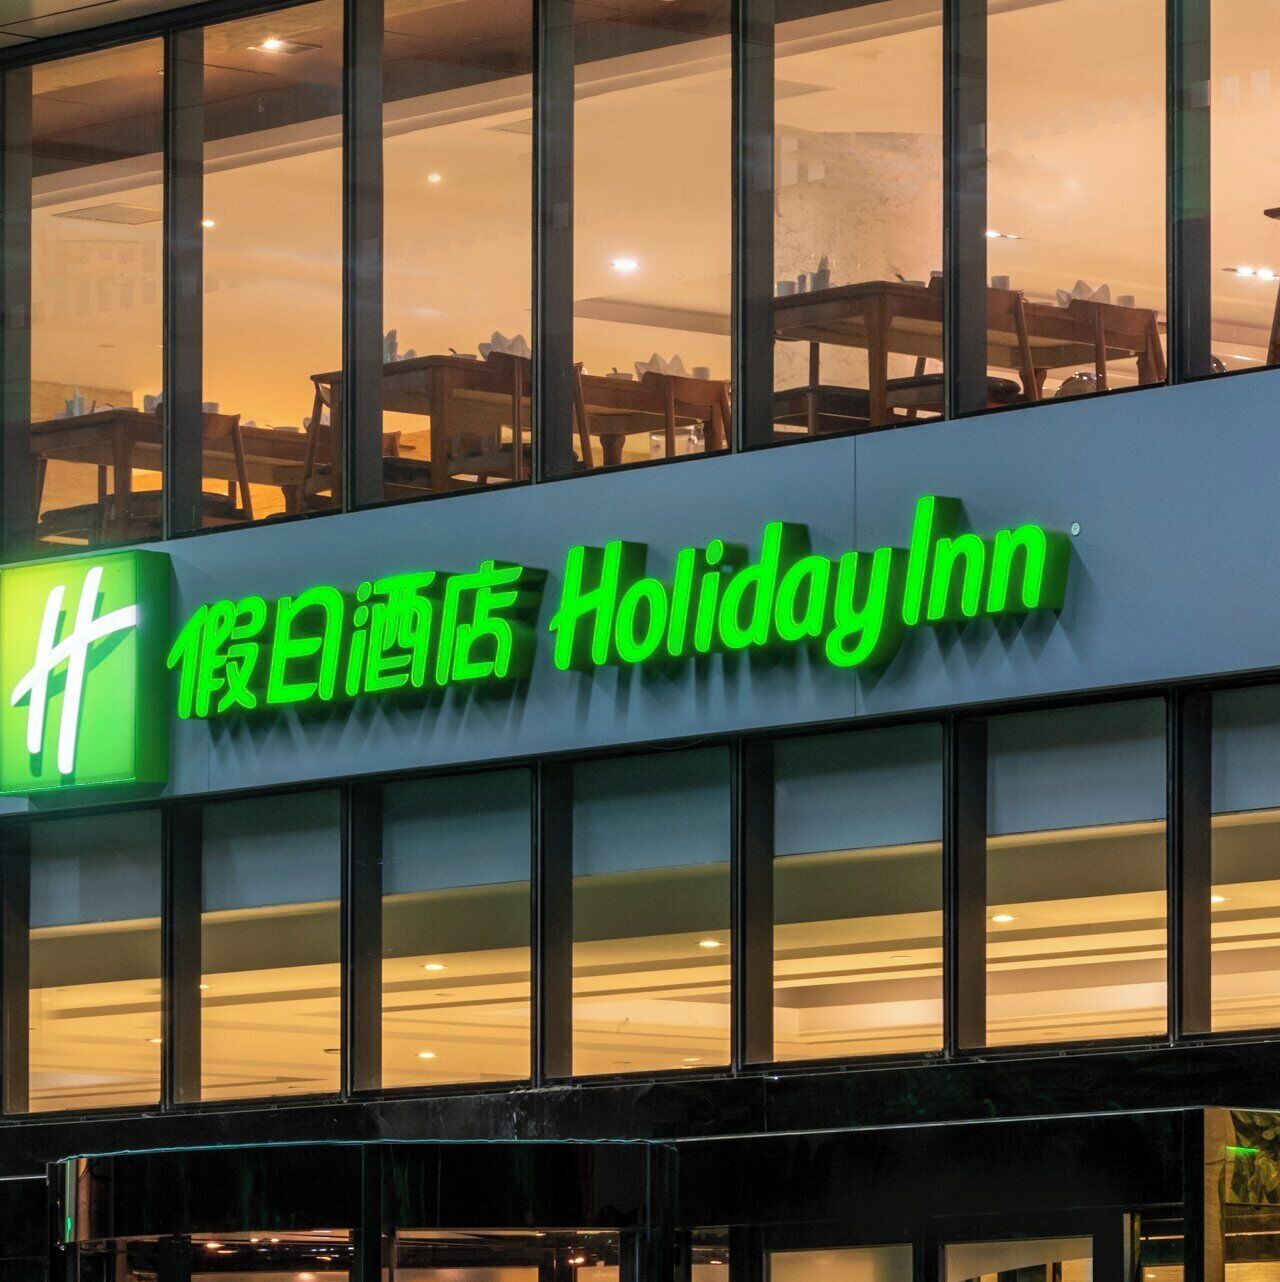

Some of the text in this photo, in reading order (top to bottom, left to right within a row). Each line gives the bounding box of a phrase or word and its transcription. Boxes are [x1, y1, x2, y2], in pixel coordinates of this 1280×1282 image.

[166, 559, 523, 720] 假日酒店
[549, 495, 1048, 671] Holiday Inn
